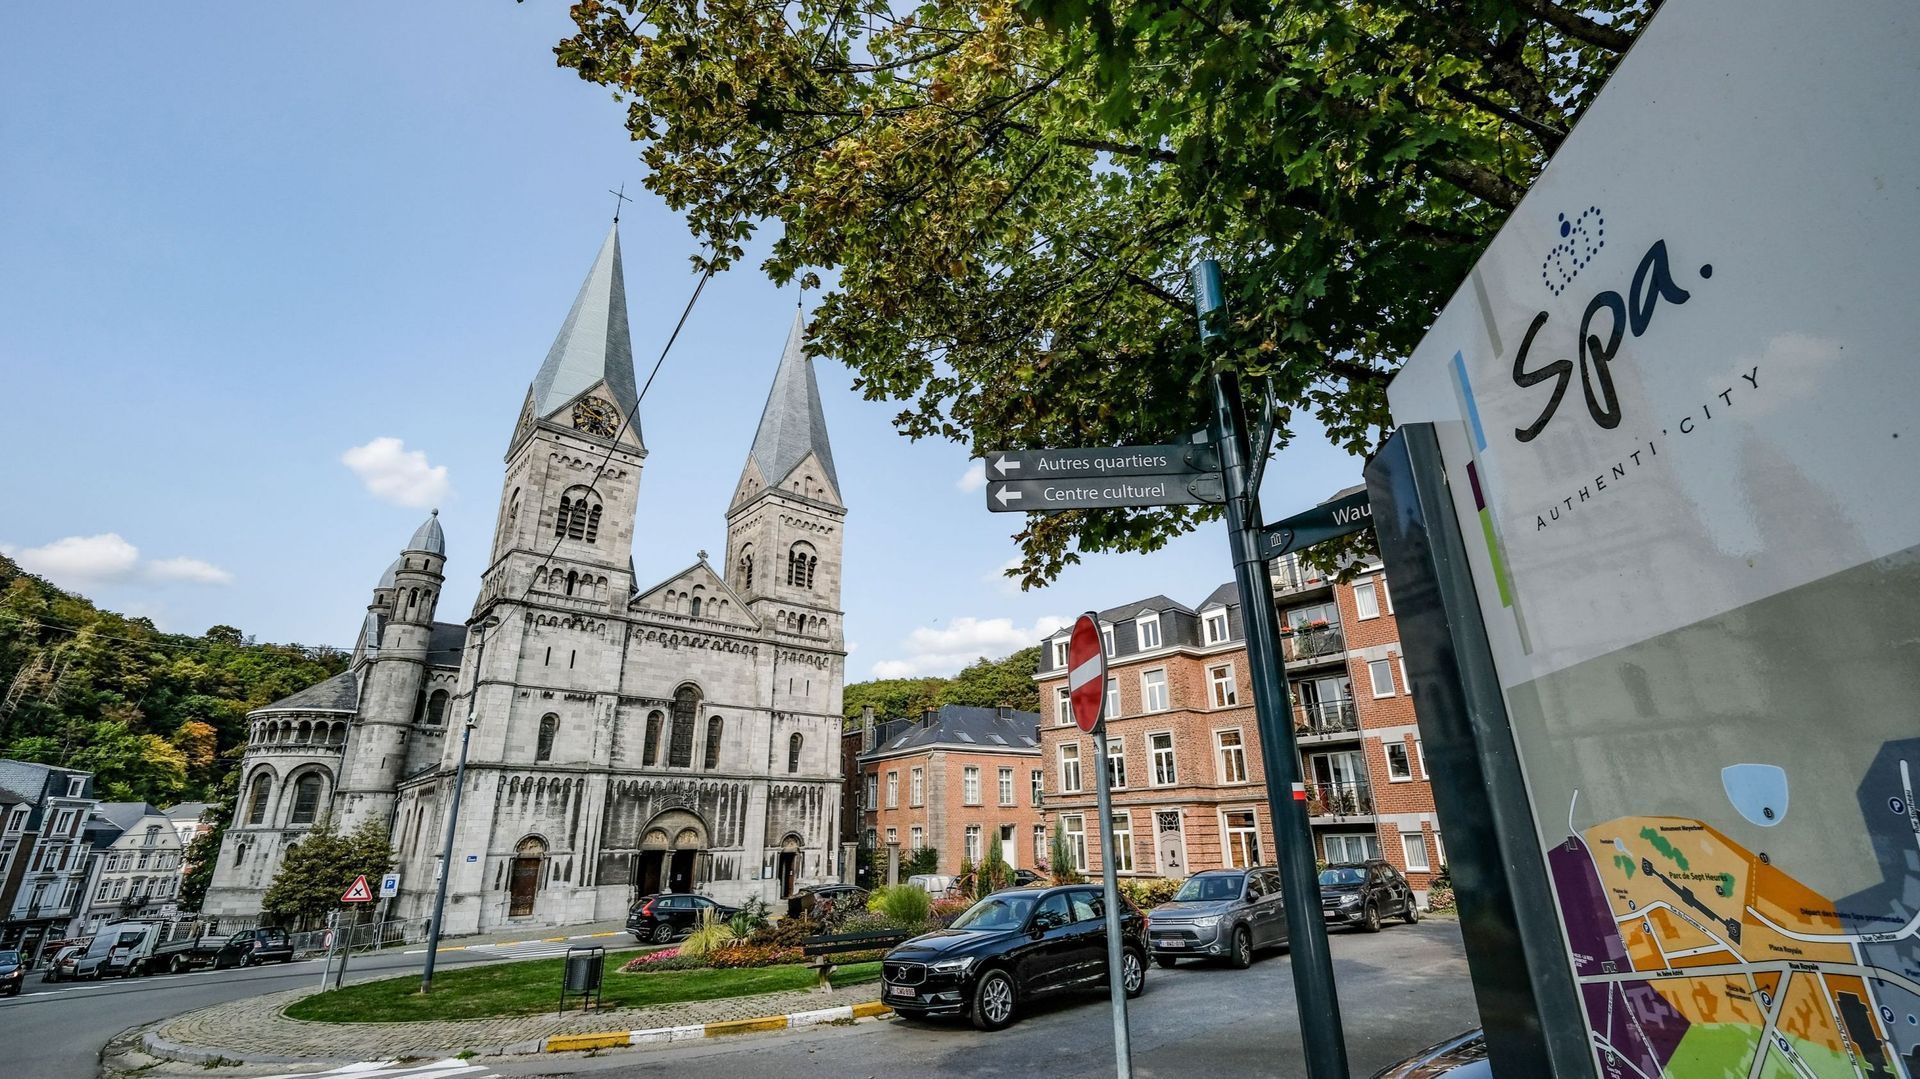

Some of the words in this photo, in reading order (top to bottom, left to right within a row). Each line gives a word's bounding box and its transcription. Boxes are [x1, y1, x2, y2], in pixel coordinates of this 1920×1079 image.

[1513, 239, 1713, 442] Spa.
[1038, 456, 1090, 471] Autres
[1094, 453, 1167, 473] quartiers
[1043, 485, 1099, 502] Centre
[1102, 483, 1166, 500] culturel
[1691, 873, 1705, 882] Sept
[1705, 873, 1728, 882] Heures
[1788, 962, 1799, 970] Rue
[1800, 963, 1820, 972] Royale
